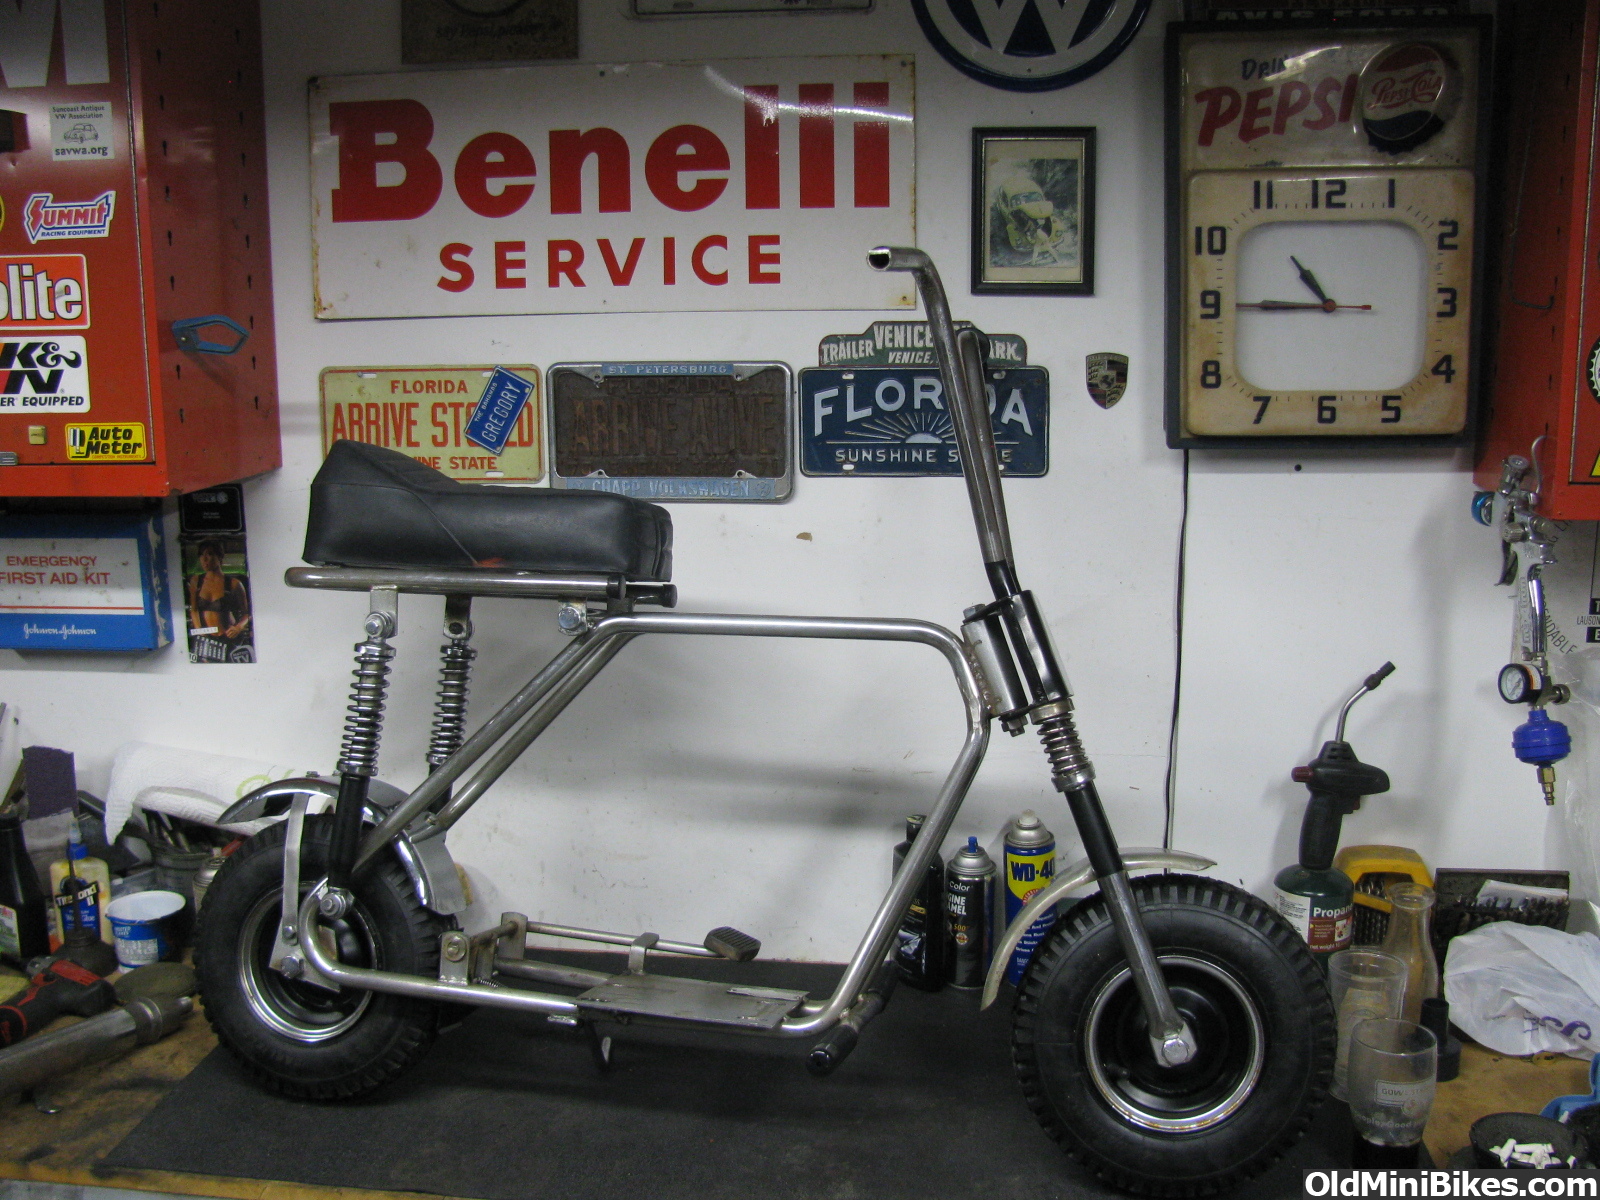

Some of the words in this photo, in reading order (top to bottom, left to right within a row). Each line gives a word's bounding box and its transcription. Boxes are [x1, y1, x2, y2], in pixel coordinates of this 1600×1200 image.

[52, 105, 80, 113] Suncoast
[80, 104, 105, 113] Antique
[1194, 73, 1359, 148] PEPSI
[54, 146, 109, 157] savwa.org
[329, 81, 891, 223] Benelli
[1253, 180, 1274, 210] 11
[1311, 178, 1347, 209] 12
[1387, 178, 1396, 208] 1
[67, 228, 106, 236] EQUIPMENT
[1194, 226, 1227, 255] 10
[1437, 220, 1459, 250] 2
[436, 233, 782, 293] SERVICE
[1200, 289, 1221, 320] 9
[1436, 287, 1457, 318] 3
[873, 324, 934, 350] VENICE
[821, 338, 875, 365] TRAILER
[988, 339, 1022, 361] ARK
[608, 365, 627, 374] ST.
[636, 364, 728, 374] PETERSBURG
[1200, 359, 1222, 389] 8
[1431, 354, 1456, 383] 4
[390, 379, 469, 394] FLORIDA
[22, 396, 85, 407] EQUIPPED
[481, 380, 521, 443] GREGORY
[814, 376, 1034, 437] FLORA
[1252, 395, 1272, 424] 7
[1316, 395, 1337, 424] 6
[1380, 395, 1402, 424] 5
[332, 402, 421, 448] ARRIVE
[431, 402, 534, 448] STD
[474, 410, 484, 422] THE
[88, 426, 133, 441] Auto
[86, 440, 143, 455] Meter
[834, 449, 937, 464] SUNSHINE
[449, 456, 498, 470] STATE
[650, 480, 750, 497] VOLKSWAGEN
[5, 555, 98, 567] EMERGENCY
[0, 571, 47, 585] FIRST
[50, 571, 79, 585] AID
[84, 571, 111, 585] KIT
[1010, 858, 1055, 883] WD-40
[56, 884, 97, 906] Titeond
[949, 880, 970, 892] Color
